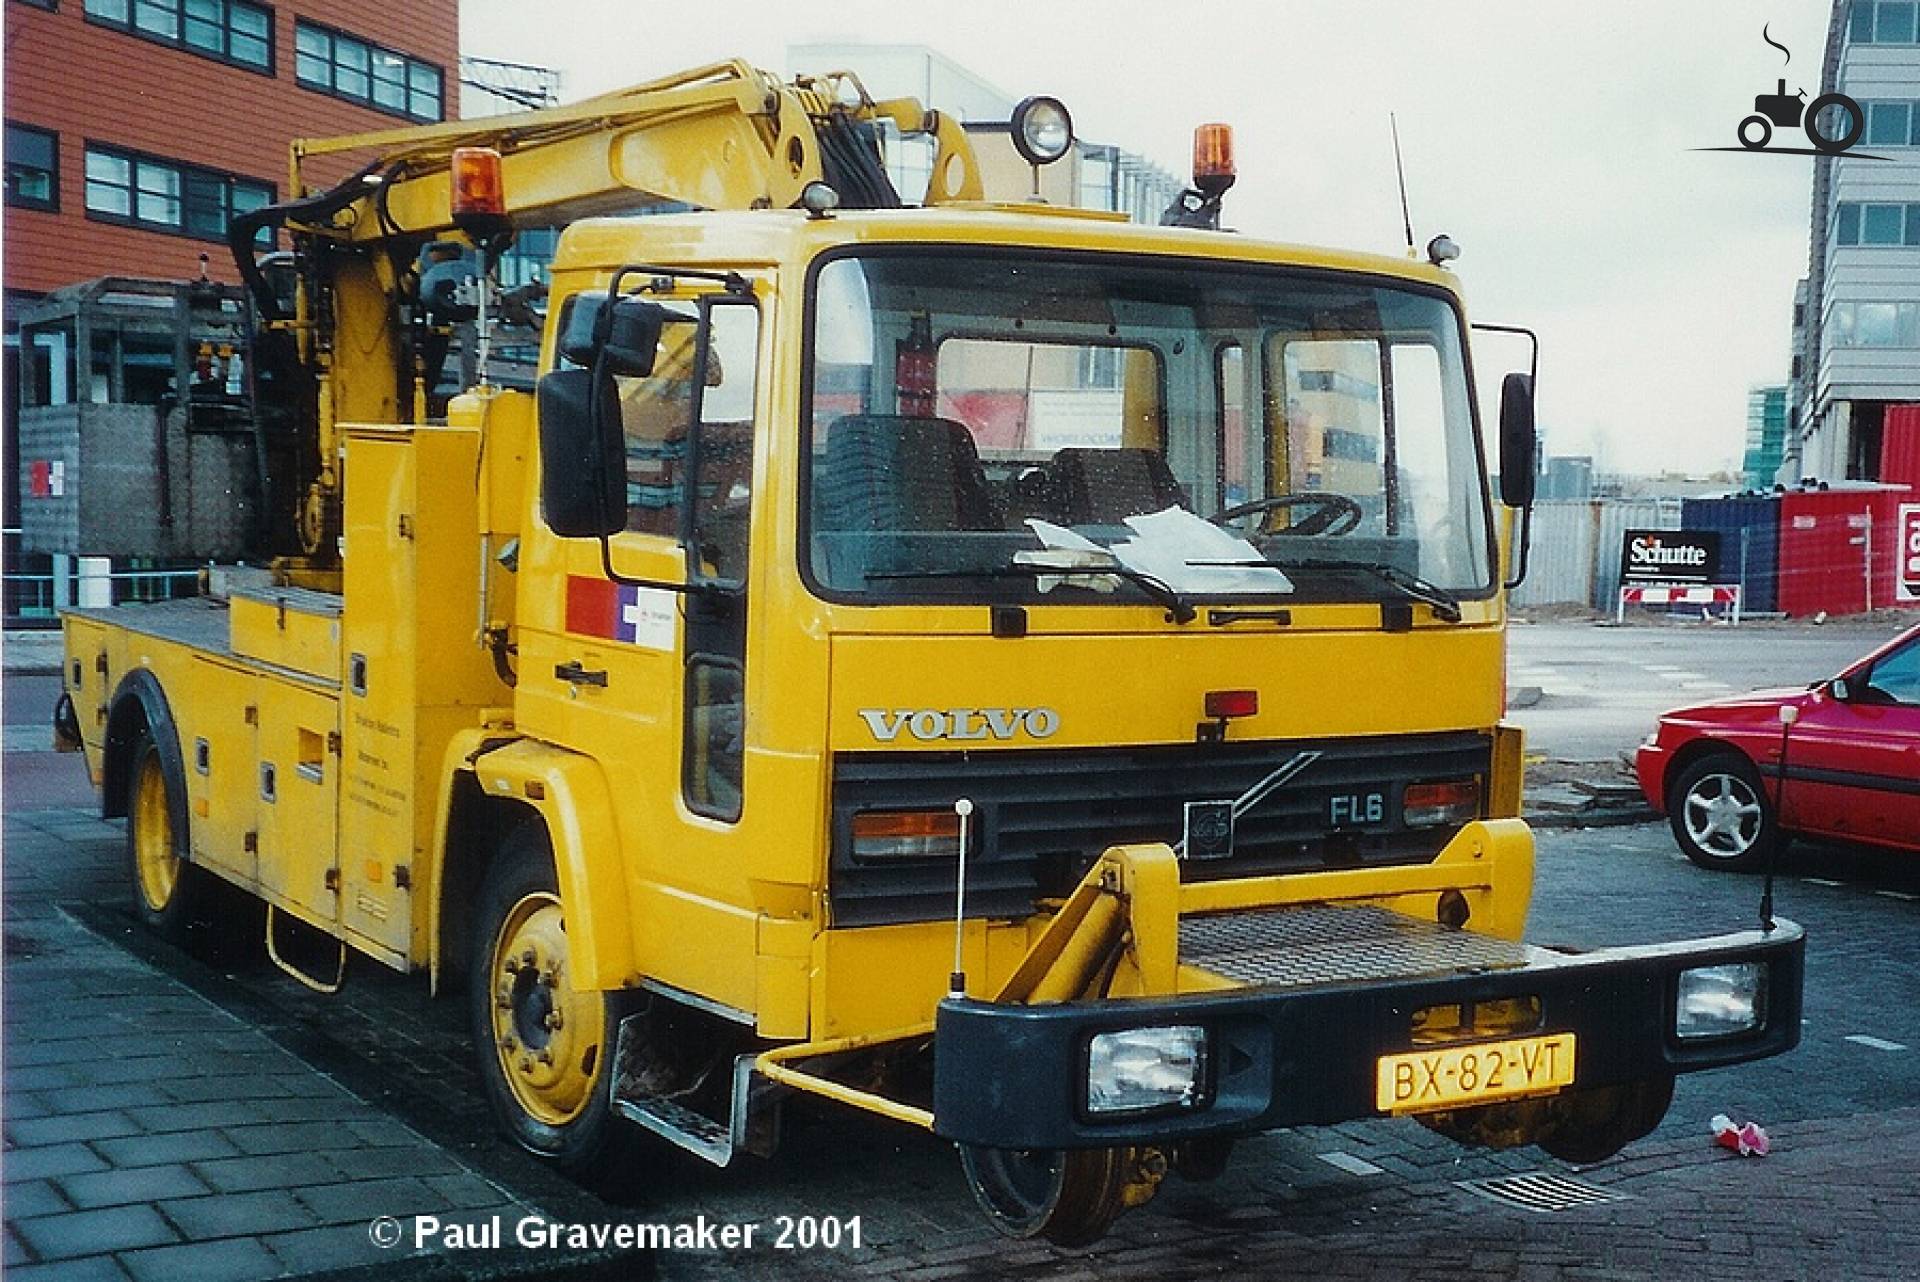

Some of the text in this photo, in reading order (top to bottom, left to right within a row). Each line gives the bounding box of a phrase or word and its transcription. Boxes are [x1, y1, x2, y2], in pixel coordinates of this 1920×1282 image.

[1630, 537, 1708, 565] Schutte
[857, 707, 1060, 741] VOLVO
[1329, 792, 1384, 826] FL6
[1395, 1041, 1561, 1100] BX-82-VT
